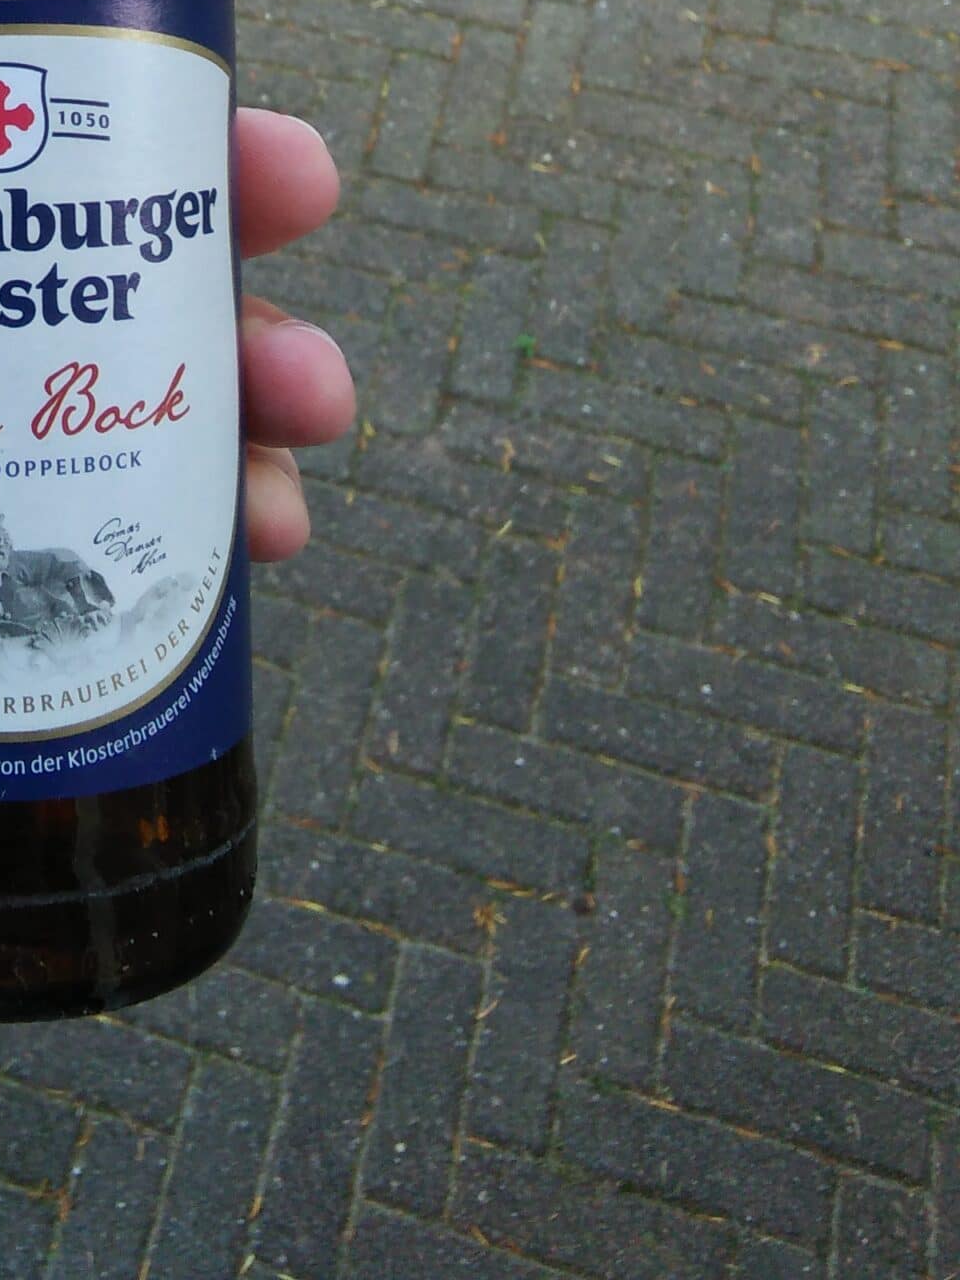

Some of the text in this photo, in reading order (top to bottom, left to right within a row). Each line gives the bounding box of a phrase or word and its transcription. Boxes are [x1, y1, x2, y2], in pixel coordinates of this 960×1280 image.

[58, 110, 111, 130] 1050
[31, 361, 191, 440] Bock
[154, 618, 190, 663] DER
[190, 547, 222, 614] WELT
[30, 754, 64, 775] der
[67, 687, 190, 770] Klosterbrauerei
[188, 593, 238, 694] Weltenburg
